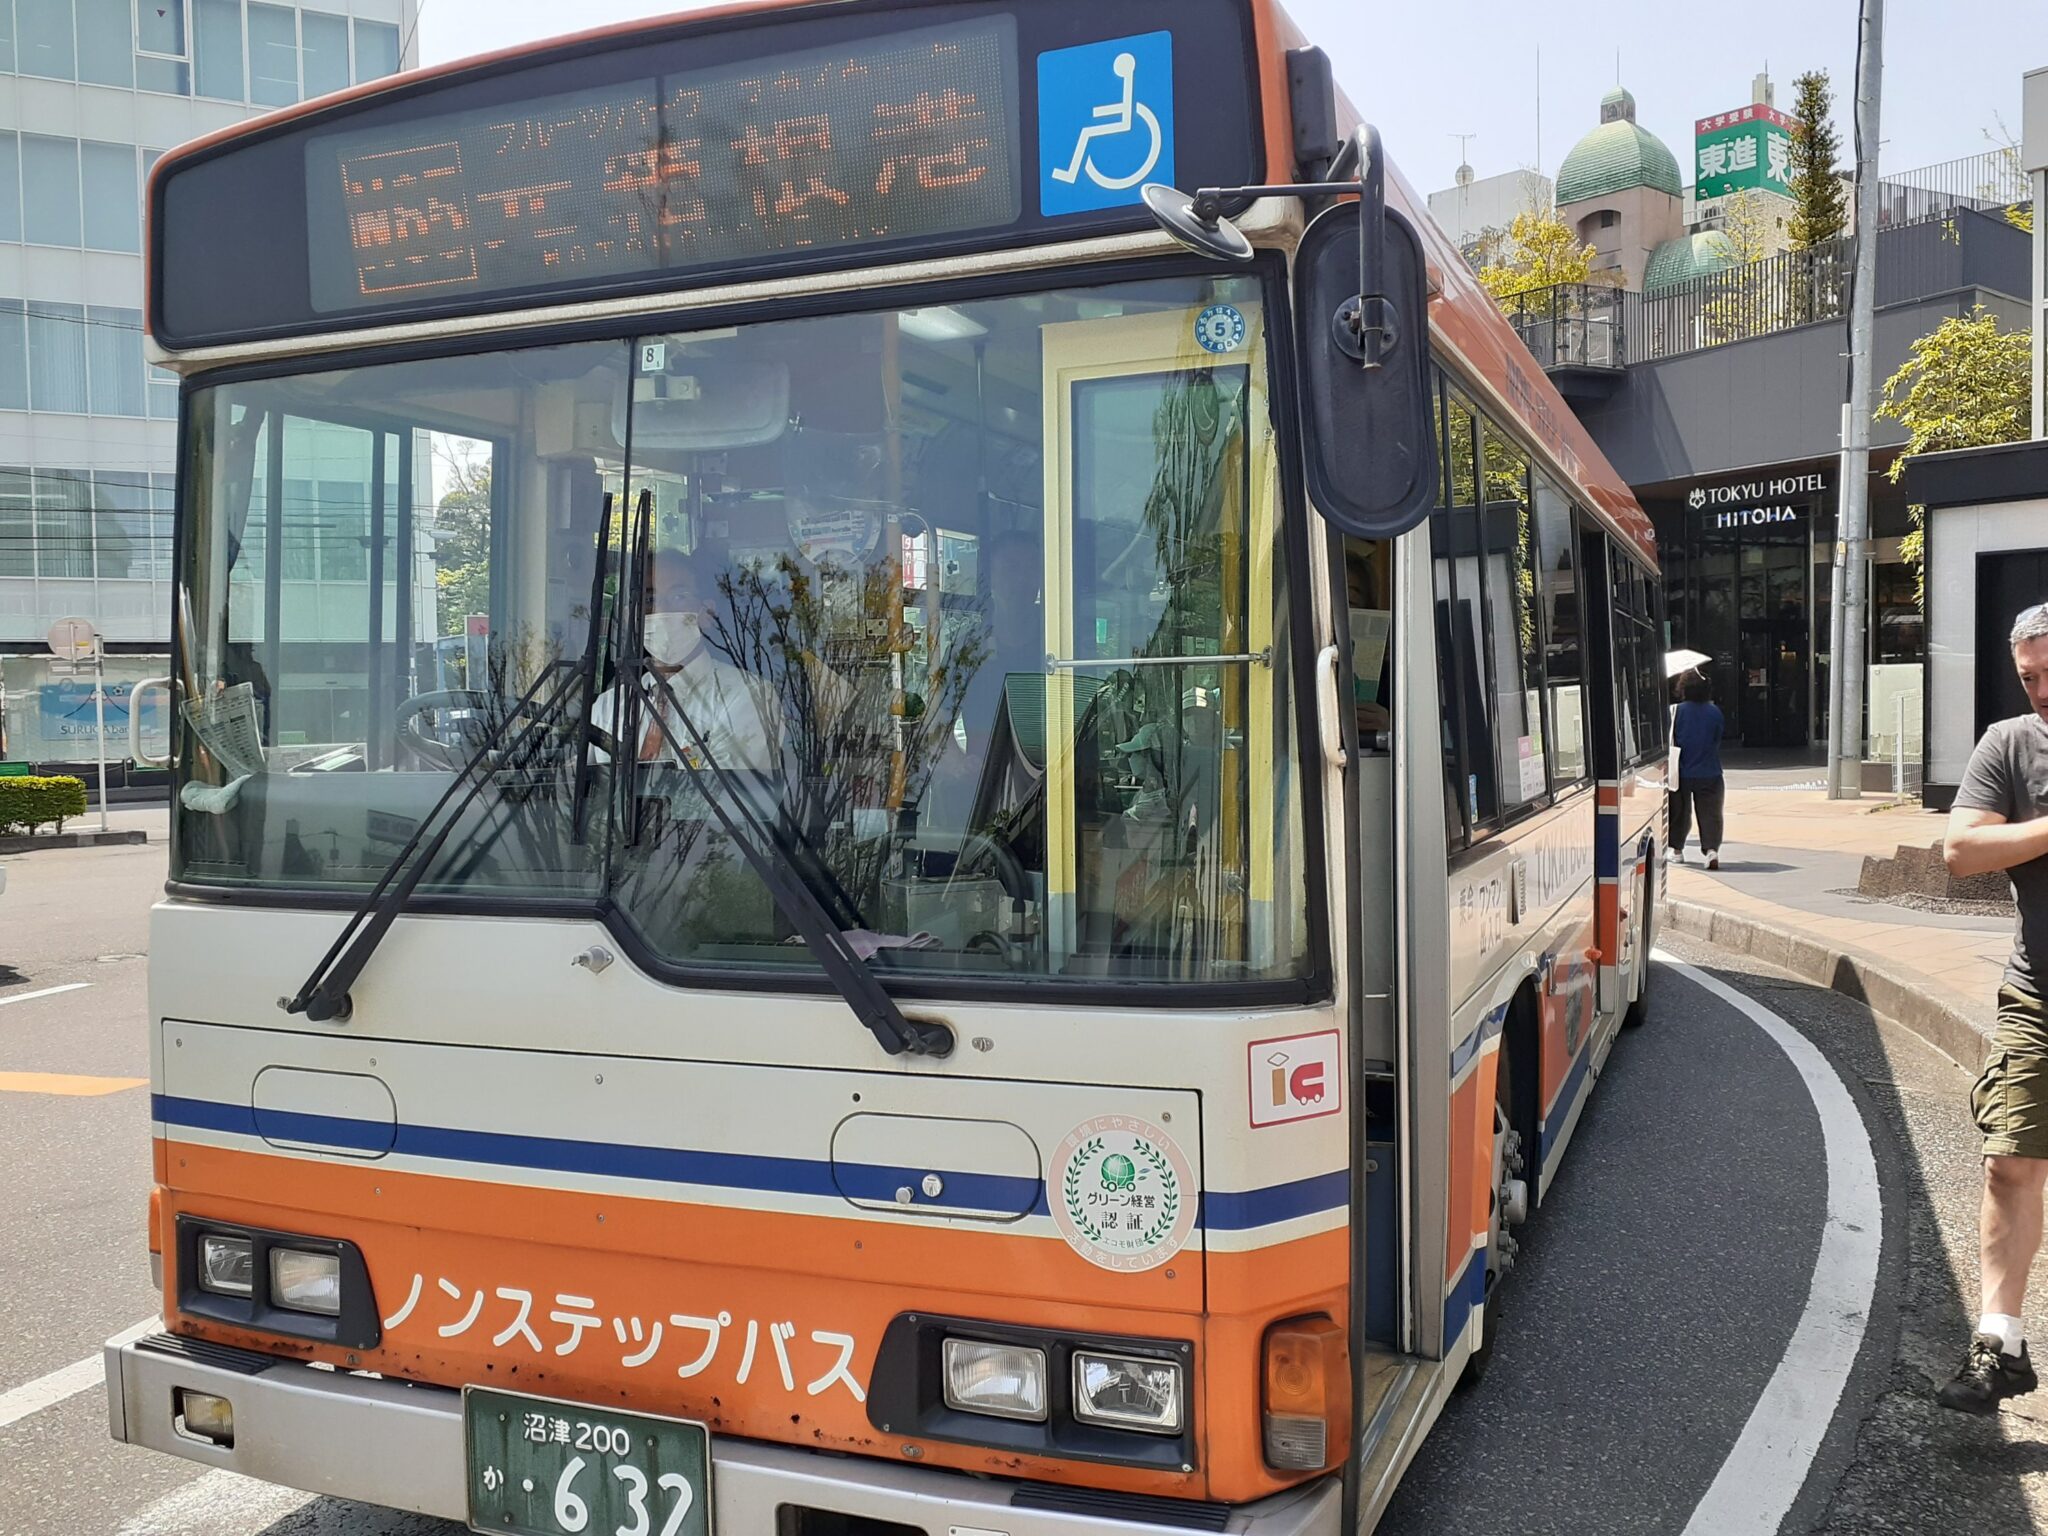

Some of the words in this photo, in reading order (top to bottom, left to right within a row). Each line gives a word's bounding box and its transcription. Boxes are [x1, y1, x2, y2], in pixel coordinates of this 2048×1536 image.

[1701, 108, 1753, 131] 大学受験
[1699, 135, 1757, 180] 東進
[1215, 322, 1225, 337] 5
[646, 347, 655, 363] 8
[1708, 482, 1764, 504] TOKYU
[1769, 473, 1827, 496] HOTEL
[1535, 825, 1569, 907] TOKAI
[1479, 877, 1502, 918] ワンマン
[1087, 1192, 1156, 1209] グリーン経営
[1100, 1211, 1144, 1230] 認証
[384, 1273, 866, 1403] ノンステップバス
[483, 1465, 504, 1491] か
